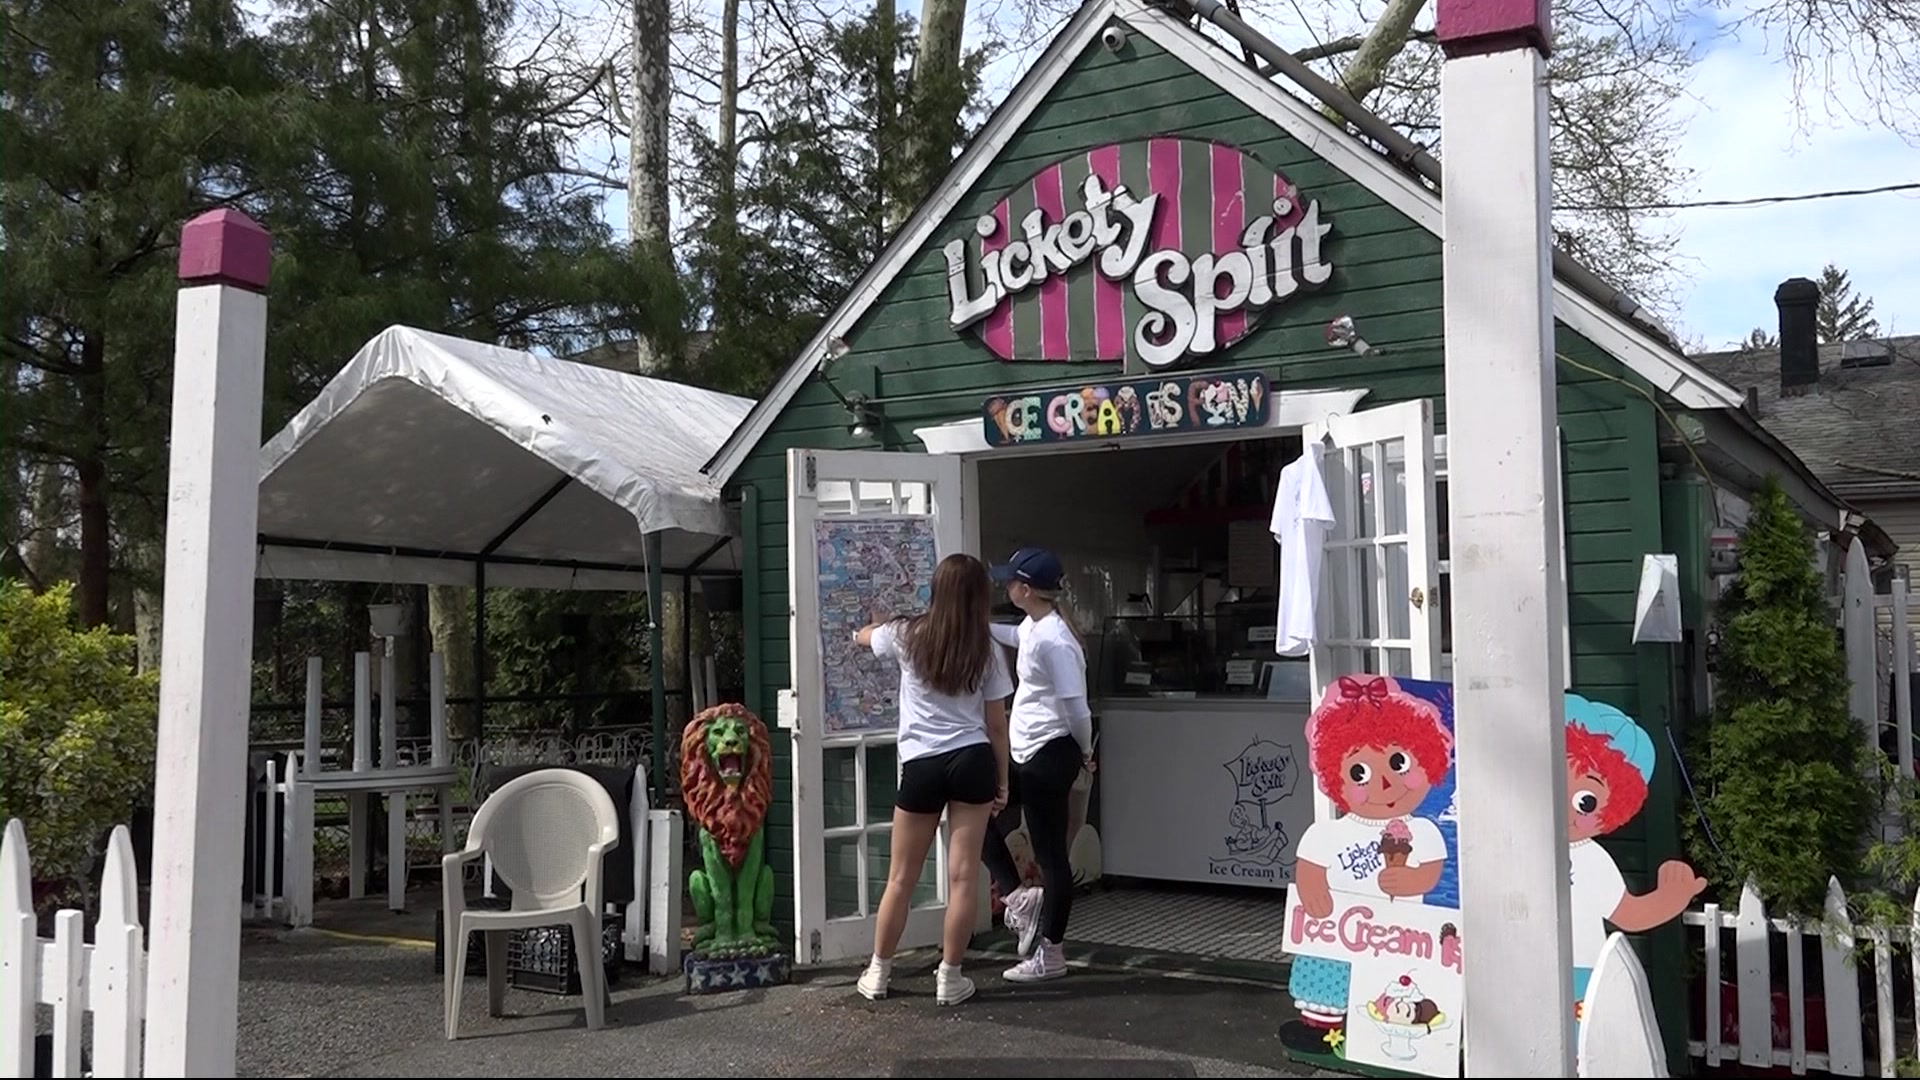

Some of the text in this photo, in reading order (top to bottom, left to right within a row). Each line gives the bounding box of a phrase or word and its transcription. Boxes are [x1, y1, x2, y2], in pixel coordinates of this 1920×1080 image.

[943, 173, 1160, 331] Lickety
[1134, 198, 1334, 367] Split
[986, 396, 1042, 444] ICE
[1046, 385, 1142, 436] CREAM
[1146, 381, 1184, 430] IS
[1209, 862, 1291, 879] Ice Cream Is
[1352, 854, 1382, 881] Split
[1290, 904, 1336, 945] Ice
[1337, 905, 1433, 960] Cream
